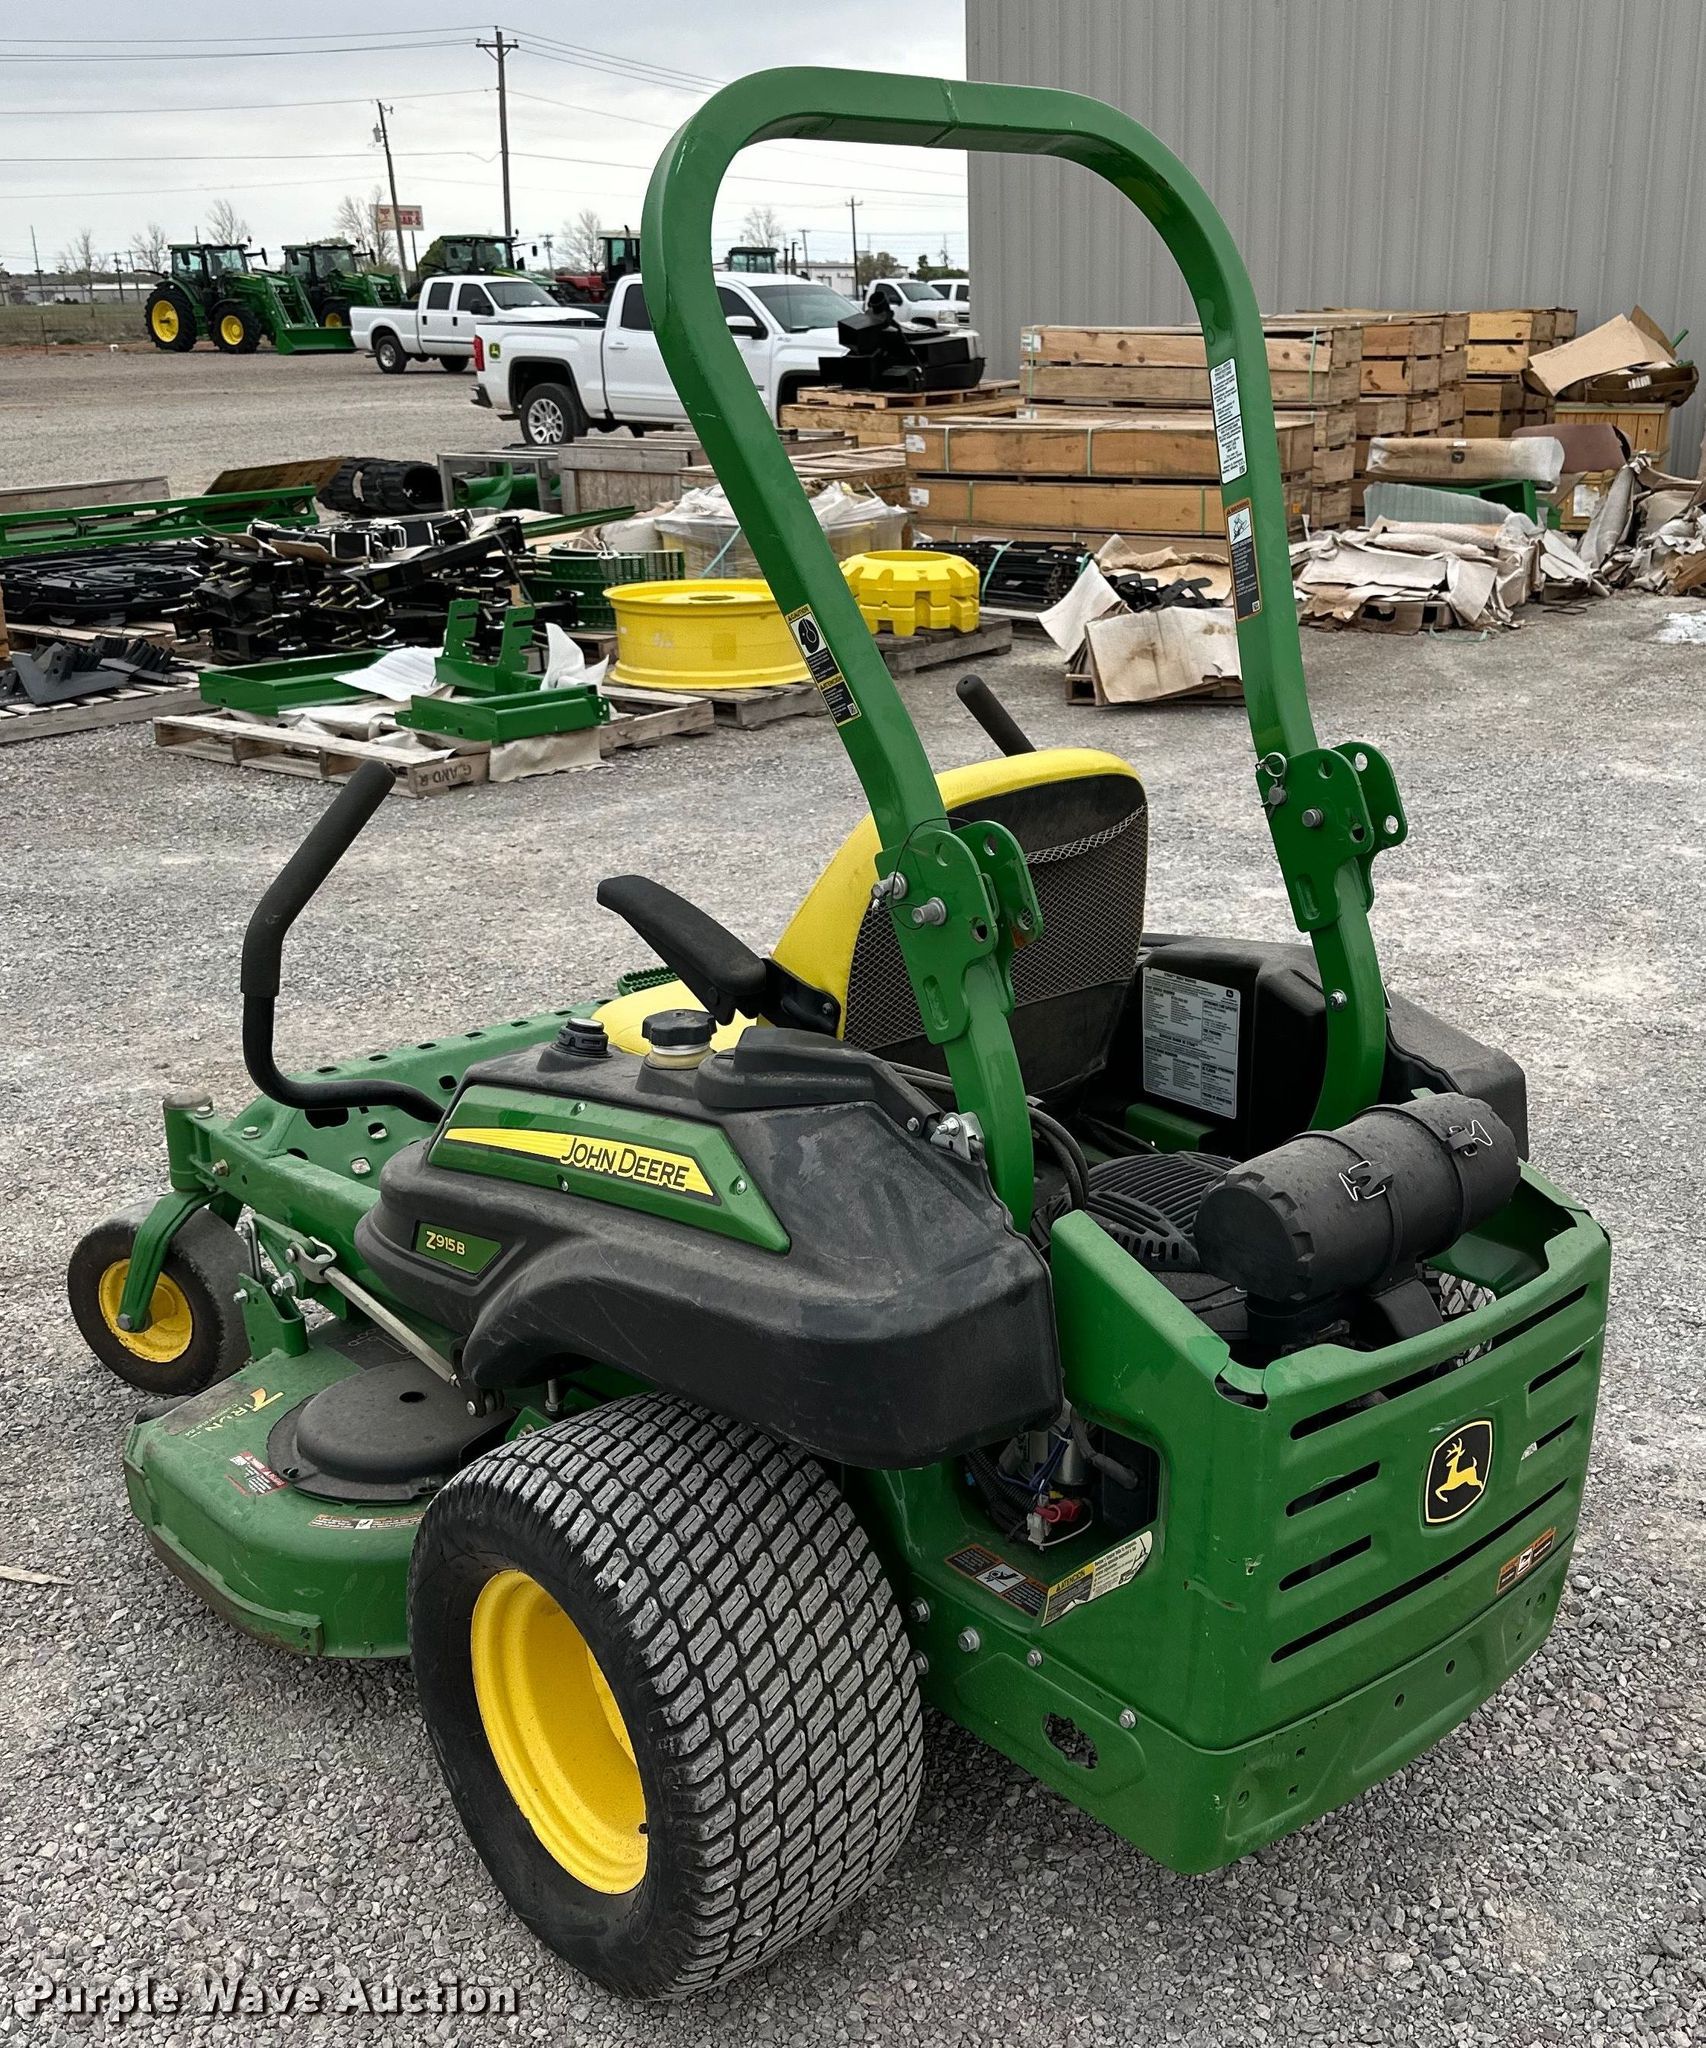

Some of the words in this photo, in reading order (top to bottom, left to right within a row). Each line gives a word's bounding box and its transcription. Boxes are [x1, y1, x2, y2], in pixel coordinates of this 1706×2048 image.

[433, 767, 459, 783] AND
[560, 1137, 617, 1171] JOHN
[616, 1148, 690, 1188] DEERE
[425, 1230, 466, 1256] Z915B
